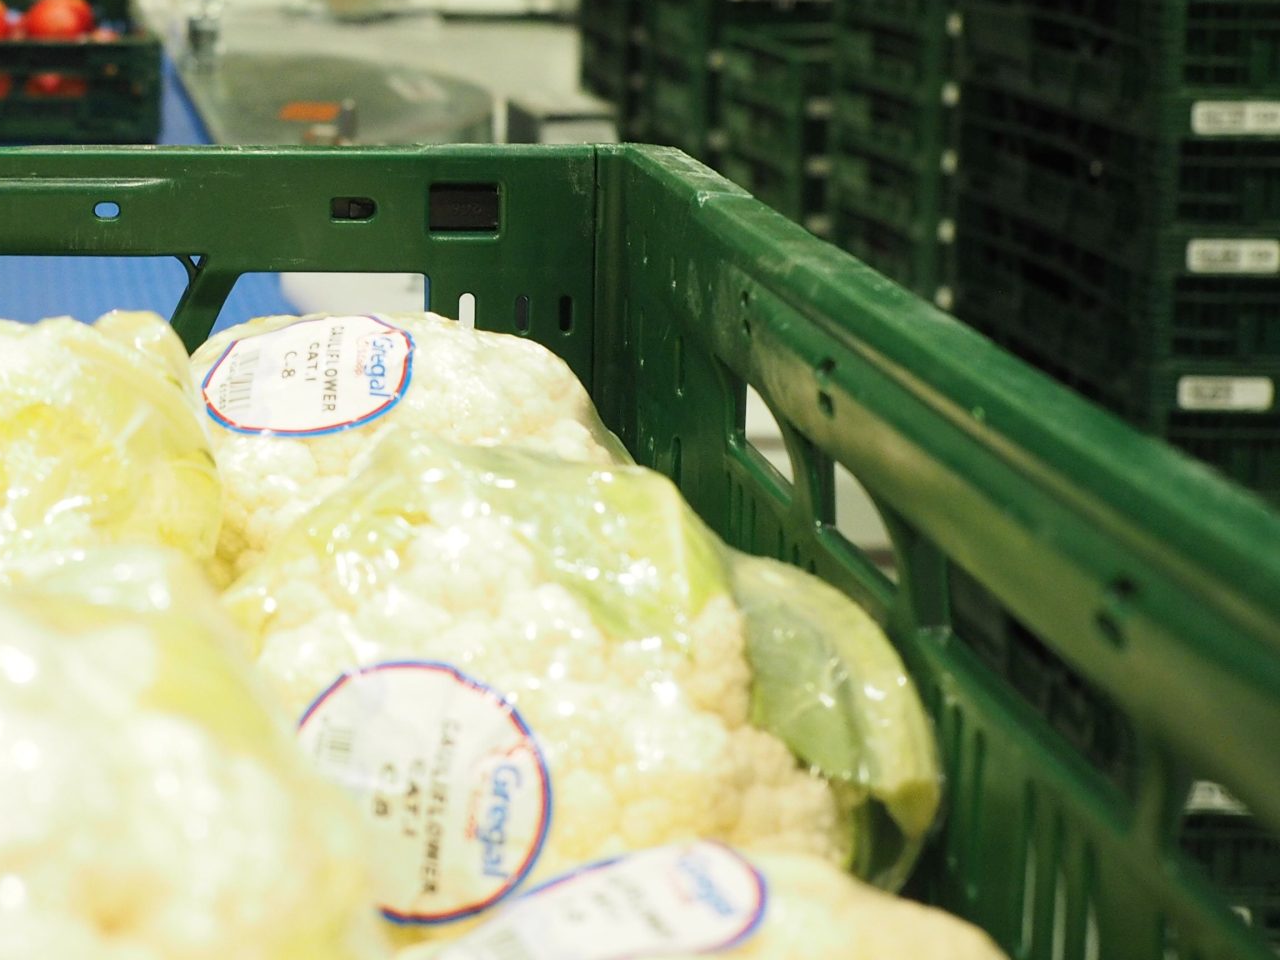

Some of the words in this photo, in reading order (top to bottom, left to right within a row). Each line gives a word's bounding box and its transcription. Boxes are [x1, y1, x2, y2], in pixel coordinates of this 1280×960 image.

[280, 350, 298, 380] C-8
[321, 325, 345, 413] CAULIFLOWER
[364, 336, 395, 398] Gregal
[476, 763, 522, 879] Gregal
